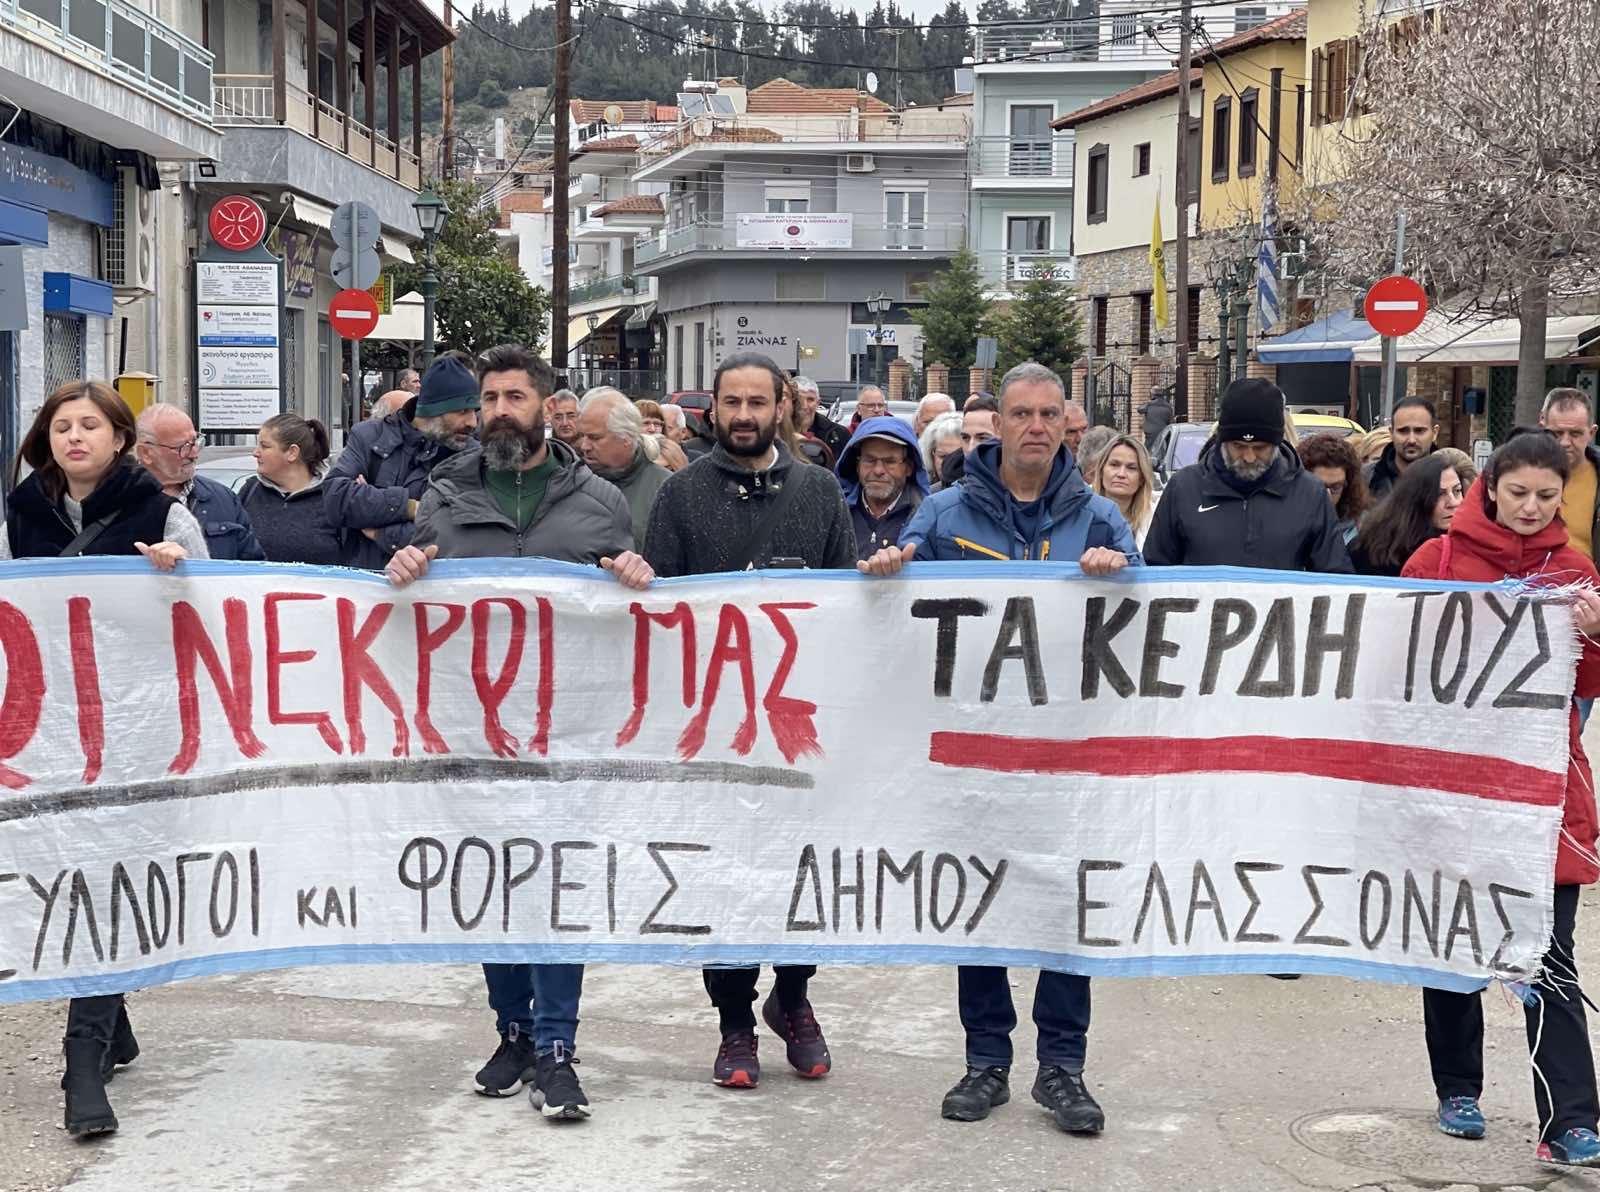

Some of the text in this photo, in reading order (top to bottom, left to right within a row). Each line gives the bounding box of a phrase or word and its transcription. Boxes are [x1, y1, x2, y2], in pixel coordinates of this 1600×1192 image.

[737, 336, 788, 346] ΖΙΑΝΝΑΣ
[167, 592, 553, 776] ΝΕΚΡΟΙ
[616, 601, 825, 764] ΜΑΣ
[911, 596, 1048, 706] ΤΑ
[1081, 593, 1367, 701] ΚΕΡΔΗ
[1396, 590, 1576, 709] ΤΟΥΣ
[398, 835, 713, 936] ΦΟΡΕΙΣ
[786, 844, 1009, 936] ΔΗΜΟΥ
[1077, 859, 1535, 978] ΕΛΑΣΣΟΝΑΣ
